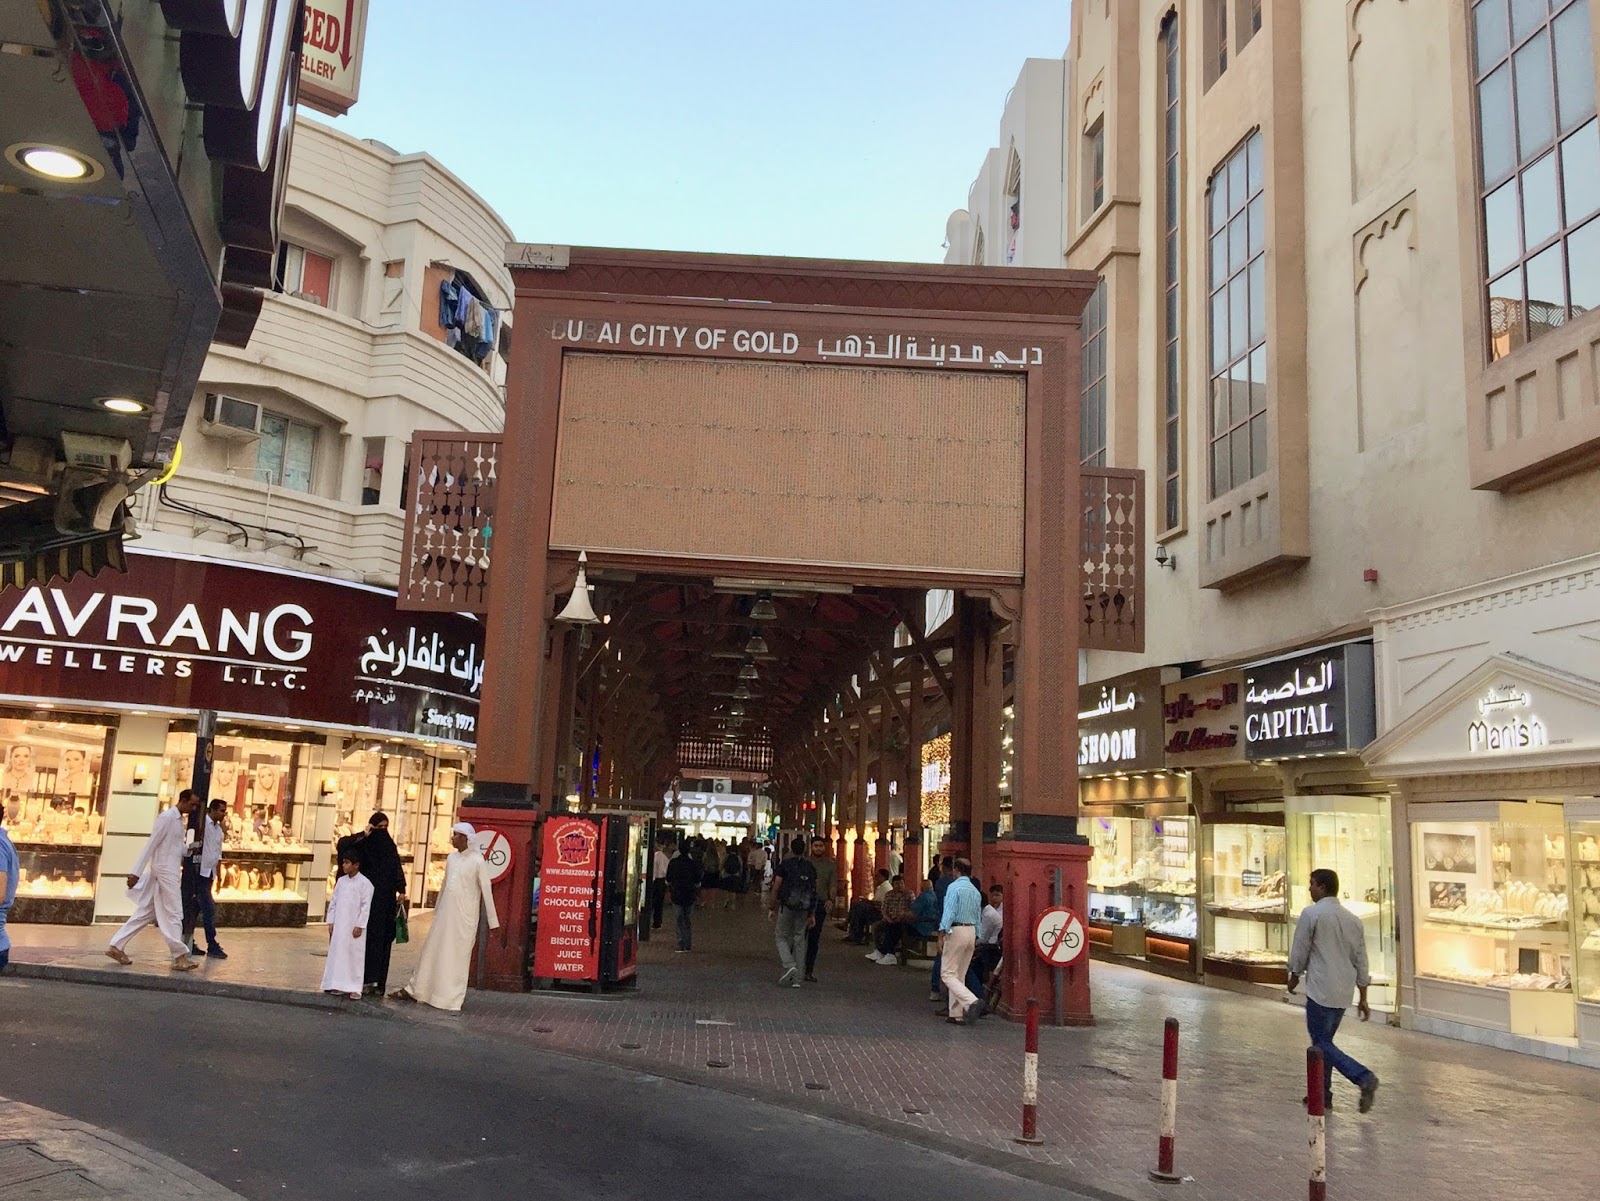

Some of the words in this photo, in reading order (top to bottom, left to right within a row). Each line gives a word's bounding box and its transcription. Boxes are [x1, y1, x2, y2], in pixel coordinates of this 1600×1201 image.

[629, 323, 688, 348] CITY
[694, 327, 727, 350] OF
[732, 330, 799, 355] GOLD
[817, 334, 901, 360] الذهب
[906, 336, 983, 367] مدينة
[989, 347, 1043, 369] دبي
[0, 586, 313, 662] AVRANG
[361, 626, 446, 677] نافارنج
[0, 643, 193, 678] WELLERS
[223, 665, 307, 691] L.L.C.
[1246, 660, 1333, 705] العاصمة
[427, 708, 453, 729] Since
[455, 712, 475, 732] 1972
[1245, 703, 1334, 742] CAPITAL
[1078, 728, 1136, 765] SHOOM
[1467, 714, 1546, 753] Manish
[544, 885, 568, 894] SOFT
[543, 898, 602, 909] CHOCOLATS
[559, 911, 585, 920] CAKE
[550, 936, 590, 946] BISCUITS
[559, 924, 583, 933] NUTS
[553, 963, 584, 972] WATER
[557, 950, 582, 959] JUICE
